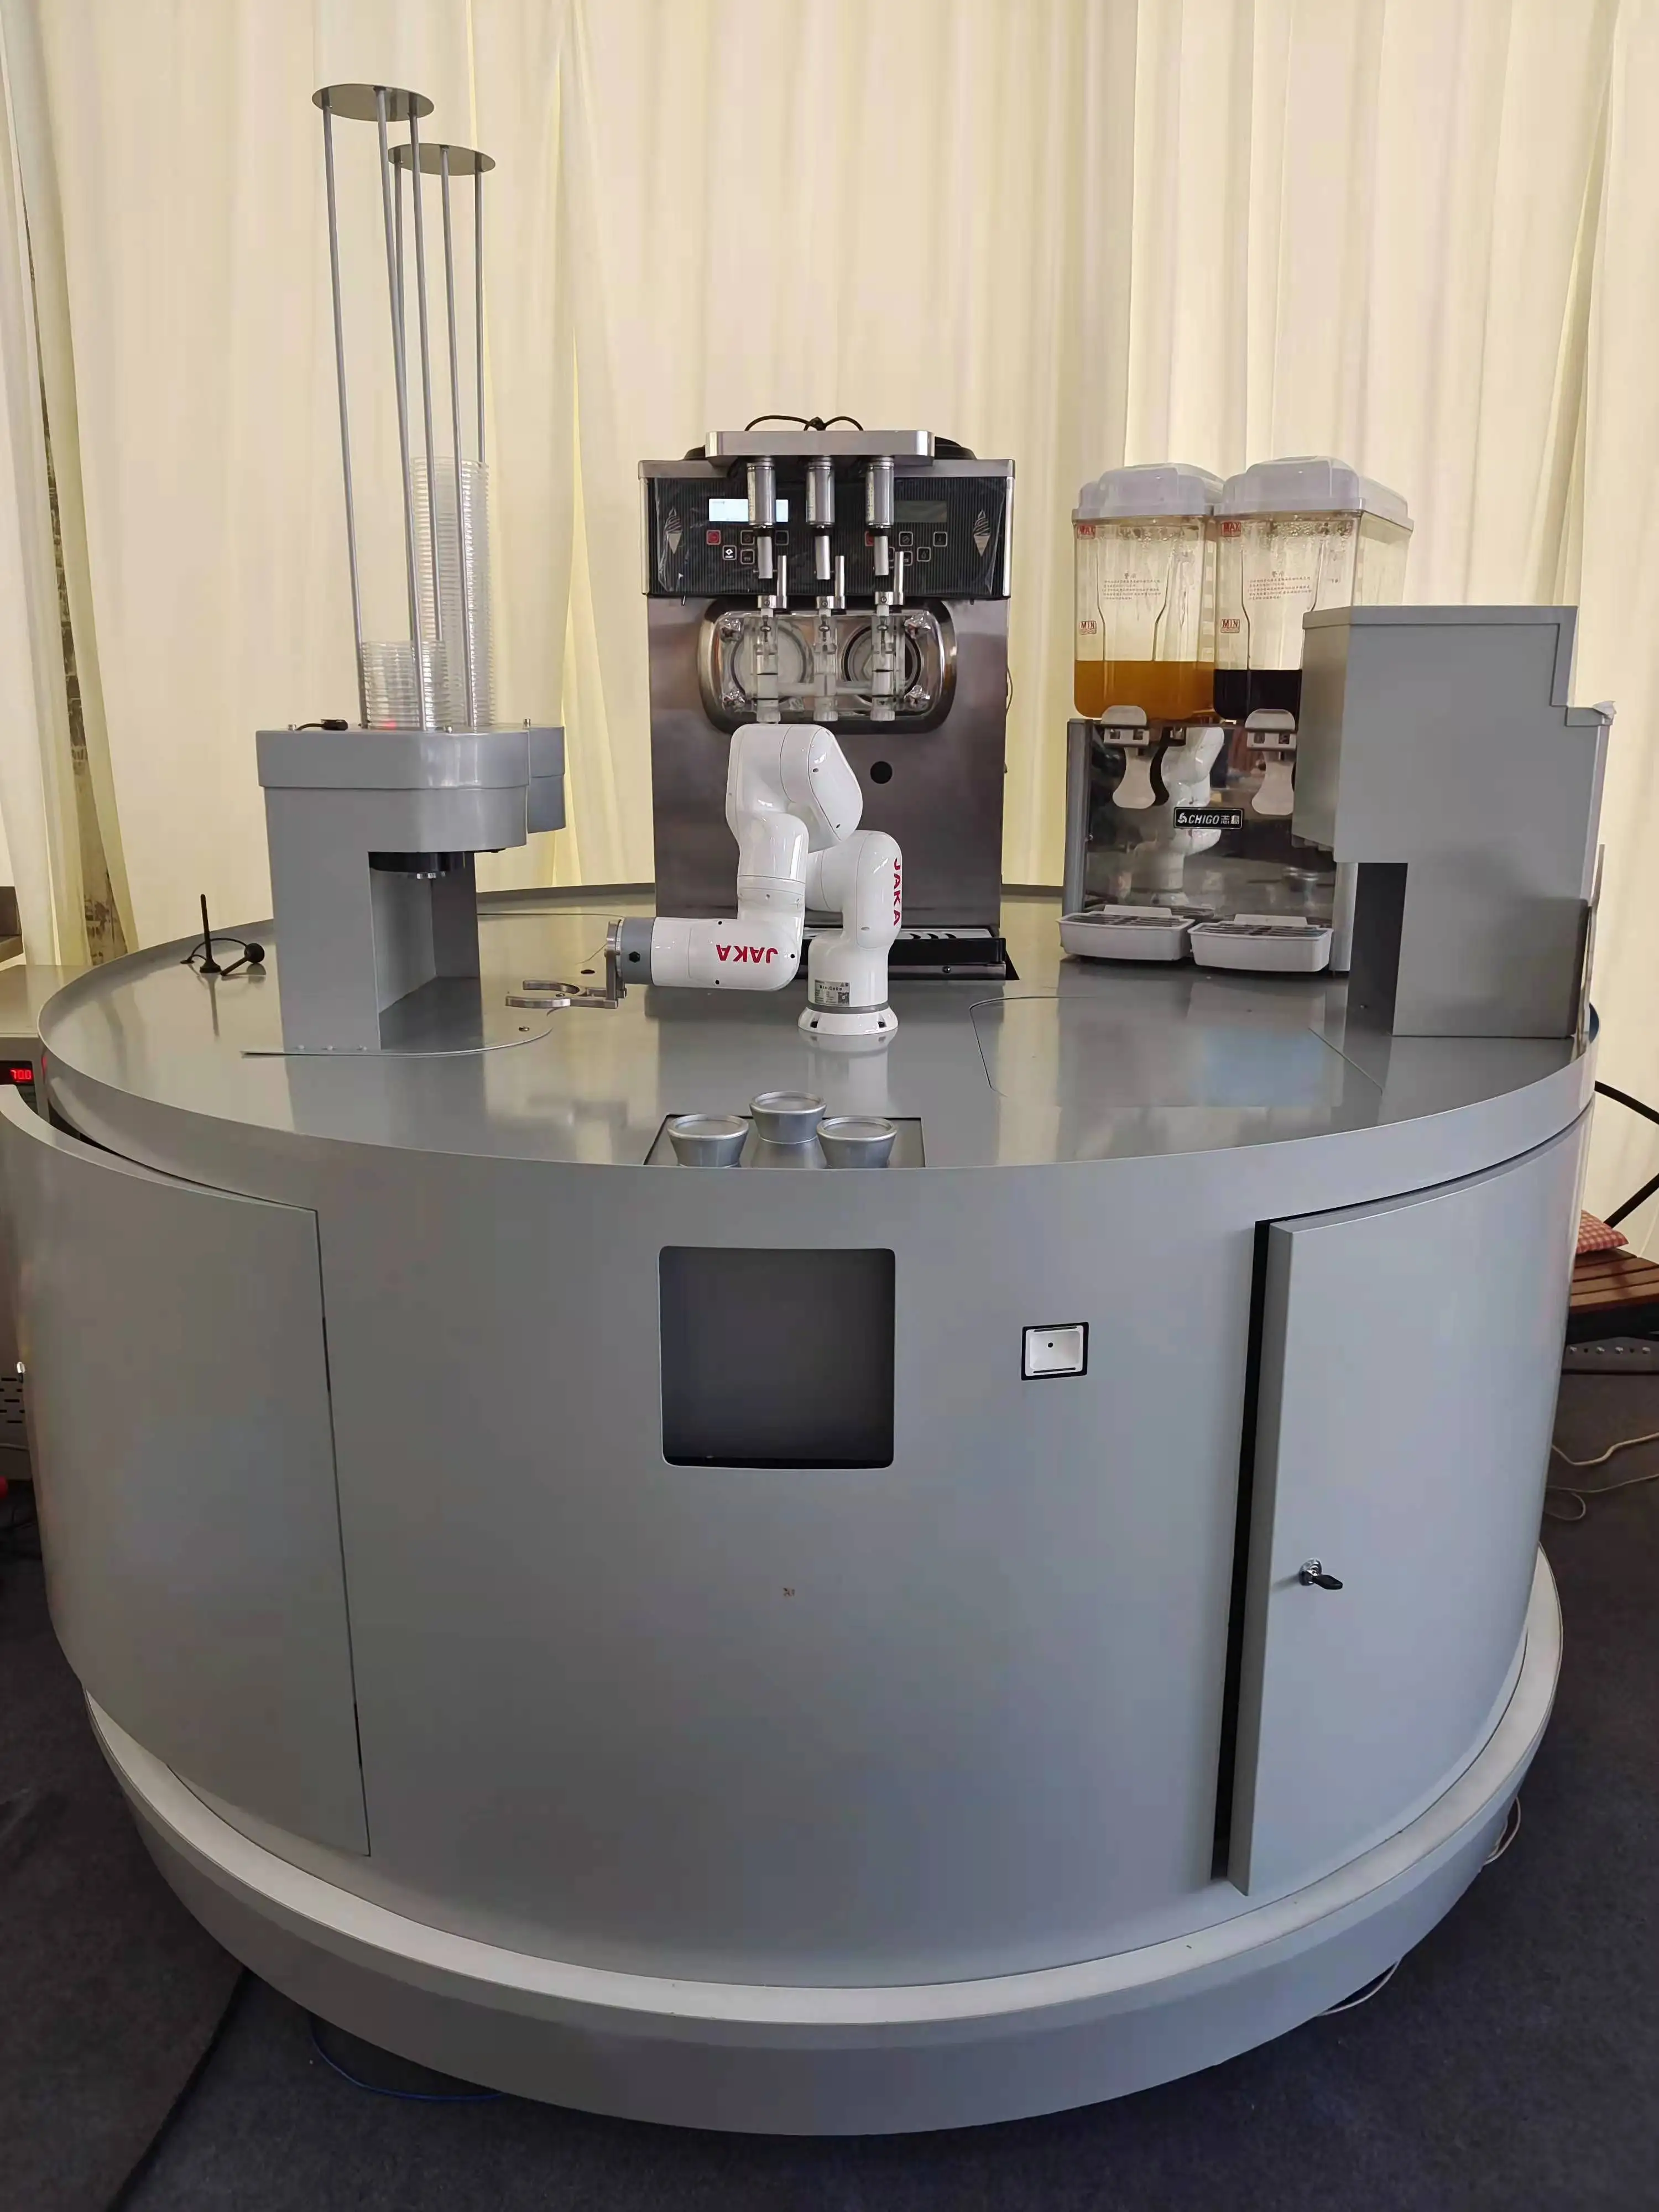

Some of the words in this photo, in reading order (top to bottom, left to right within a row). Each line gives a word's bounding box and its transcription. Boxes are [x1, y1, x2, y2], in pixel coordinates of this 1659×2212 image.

[1223, 619, 1238, 628] MIN
[1188, 815, 1220, 825] CHIGO
[716, 945, 778, 963] JAKA
